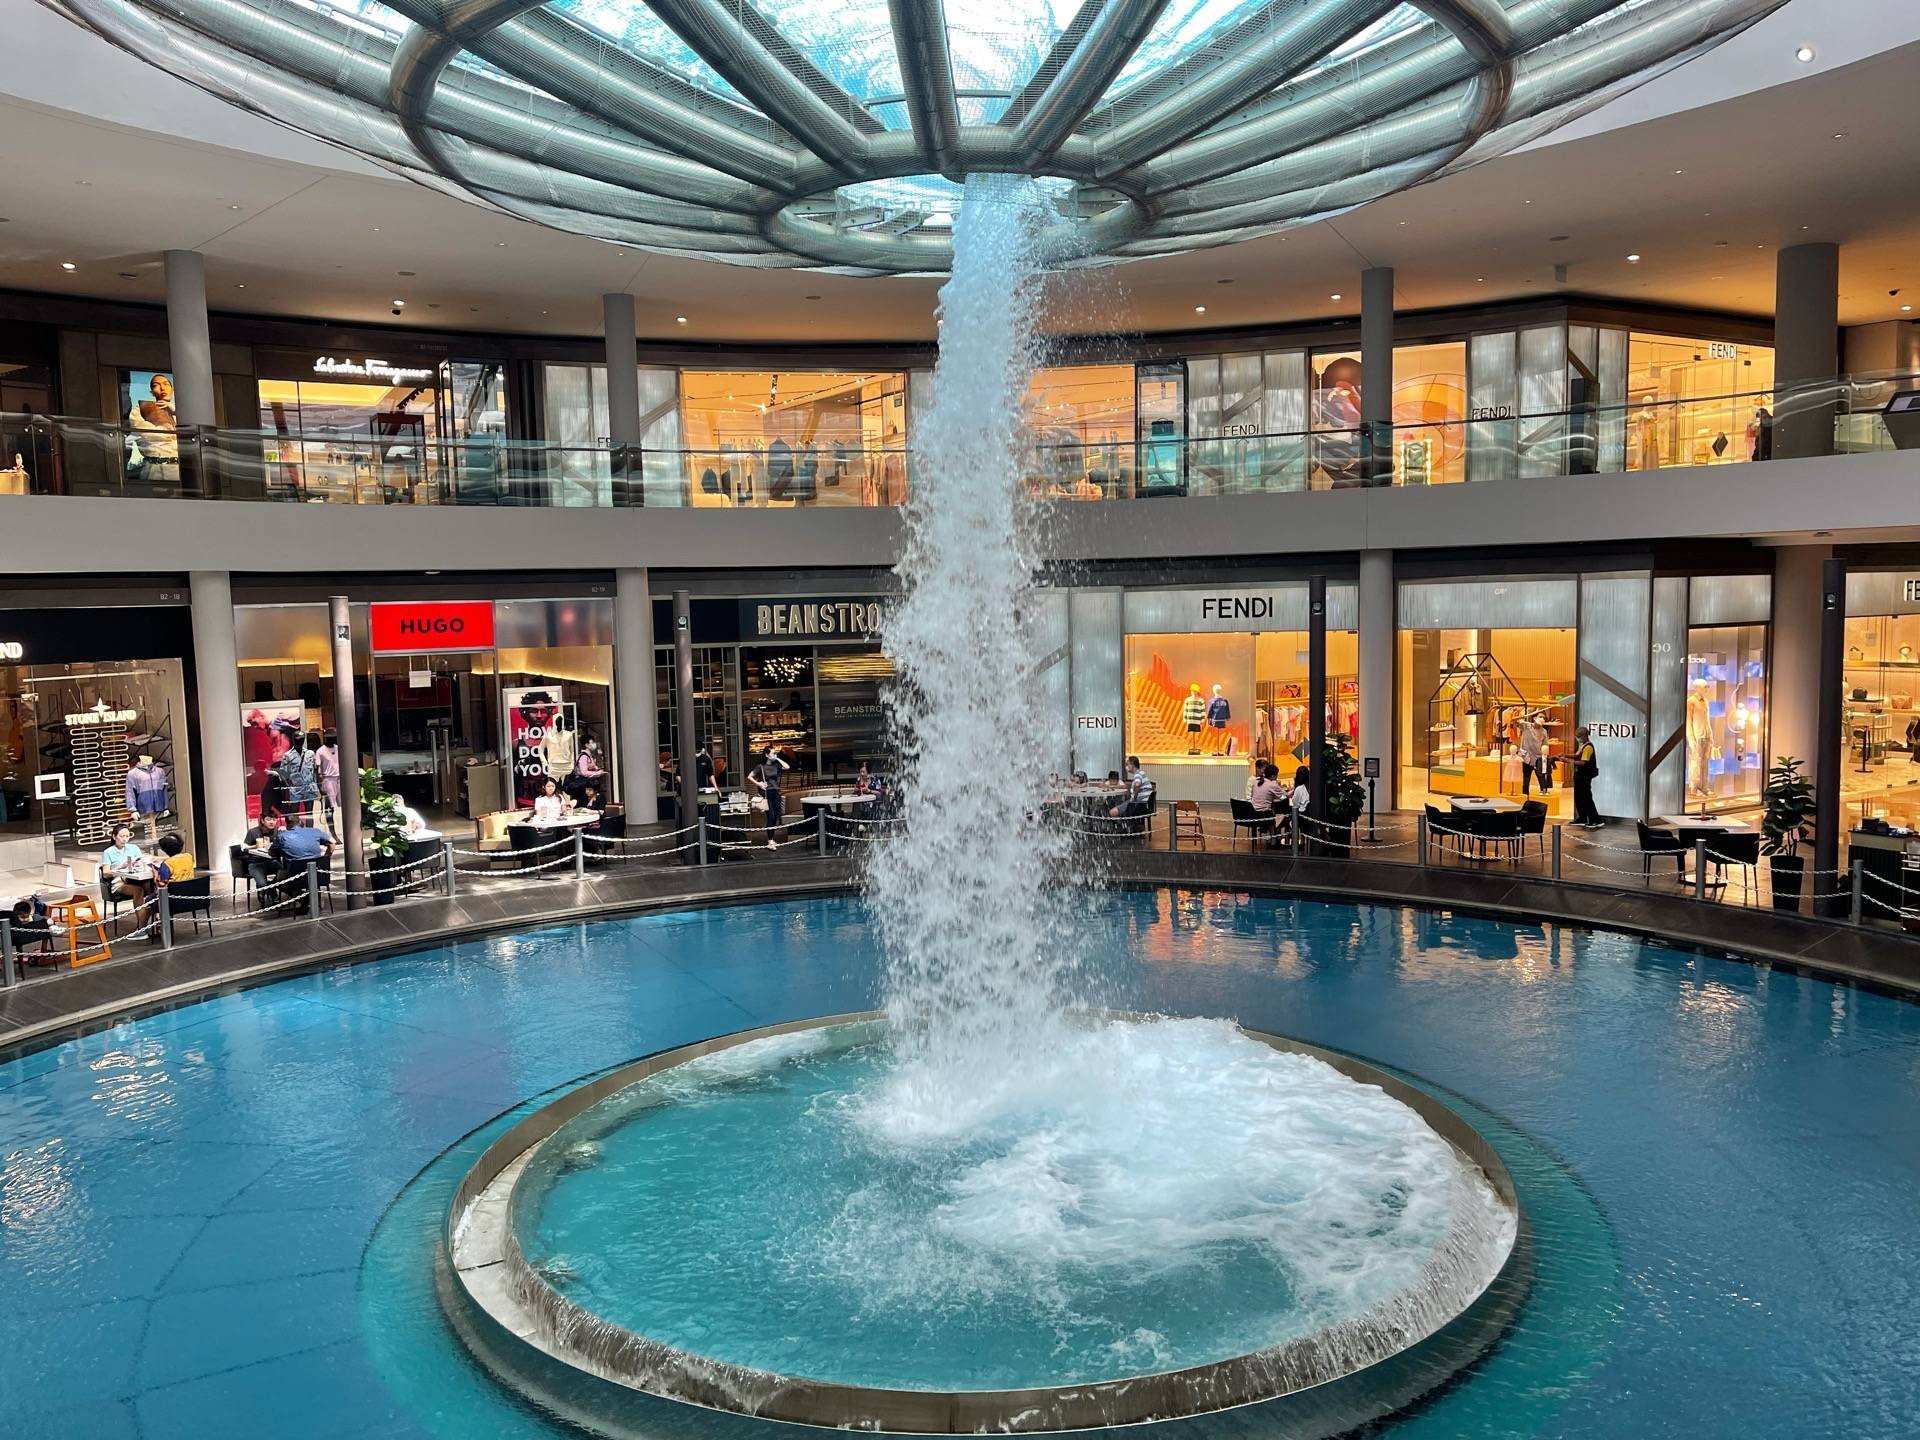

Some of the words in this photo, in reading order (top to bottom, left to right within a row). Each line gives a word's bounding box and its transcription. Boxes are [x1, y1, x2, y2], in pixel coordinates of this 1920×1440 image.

[1472, 405, 1511, 420] FENDI
[1223, 424, 1259, 437] FENDI
[1202, 596, 1273, 619] FENDI
[400, 617, 465, 634] HUGO
[757, 602, 881, 635] BEANSTRO
[64, 712, 100, 726] STONE
[102, 709, 137, 723] ISLAND
[1078, 716, 1117, 729] FENDI
[1588, 723, 1636, 738] FENDI
[519, 746, 542, 758] DO
